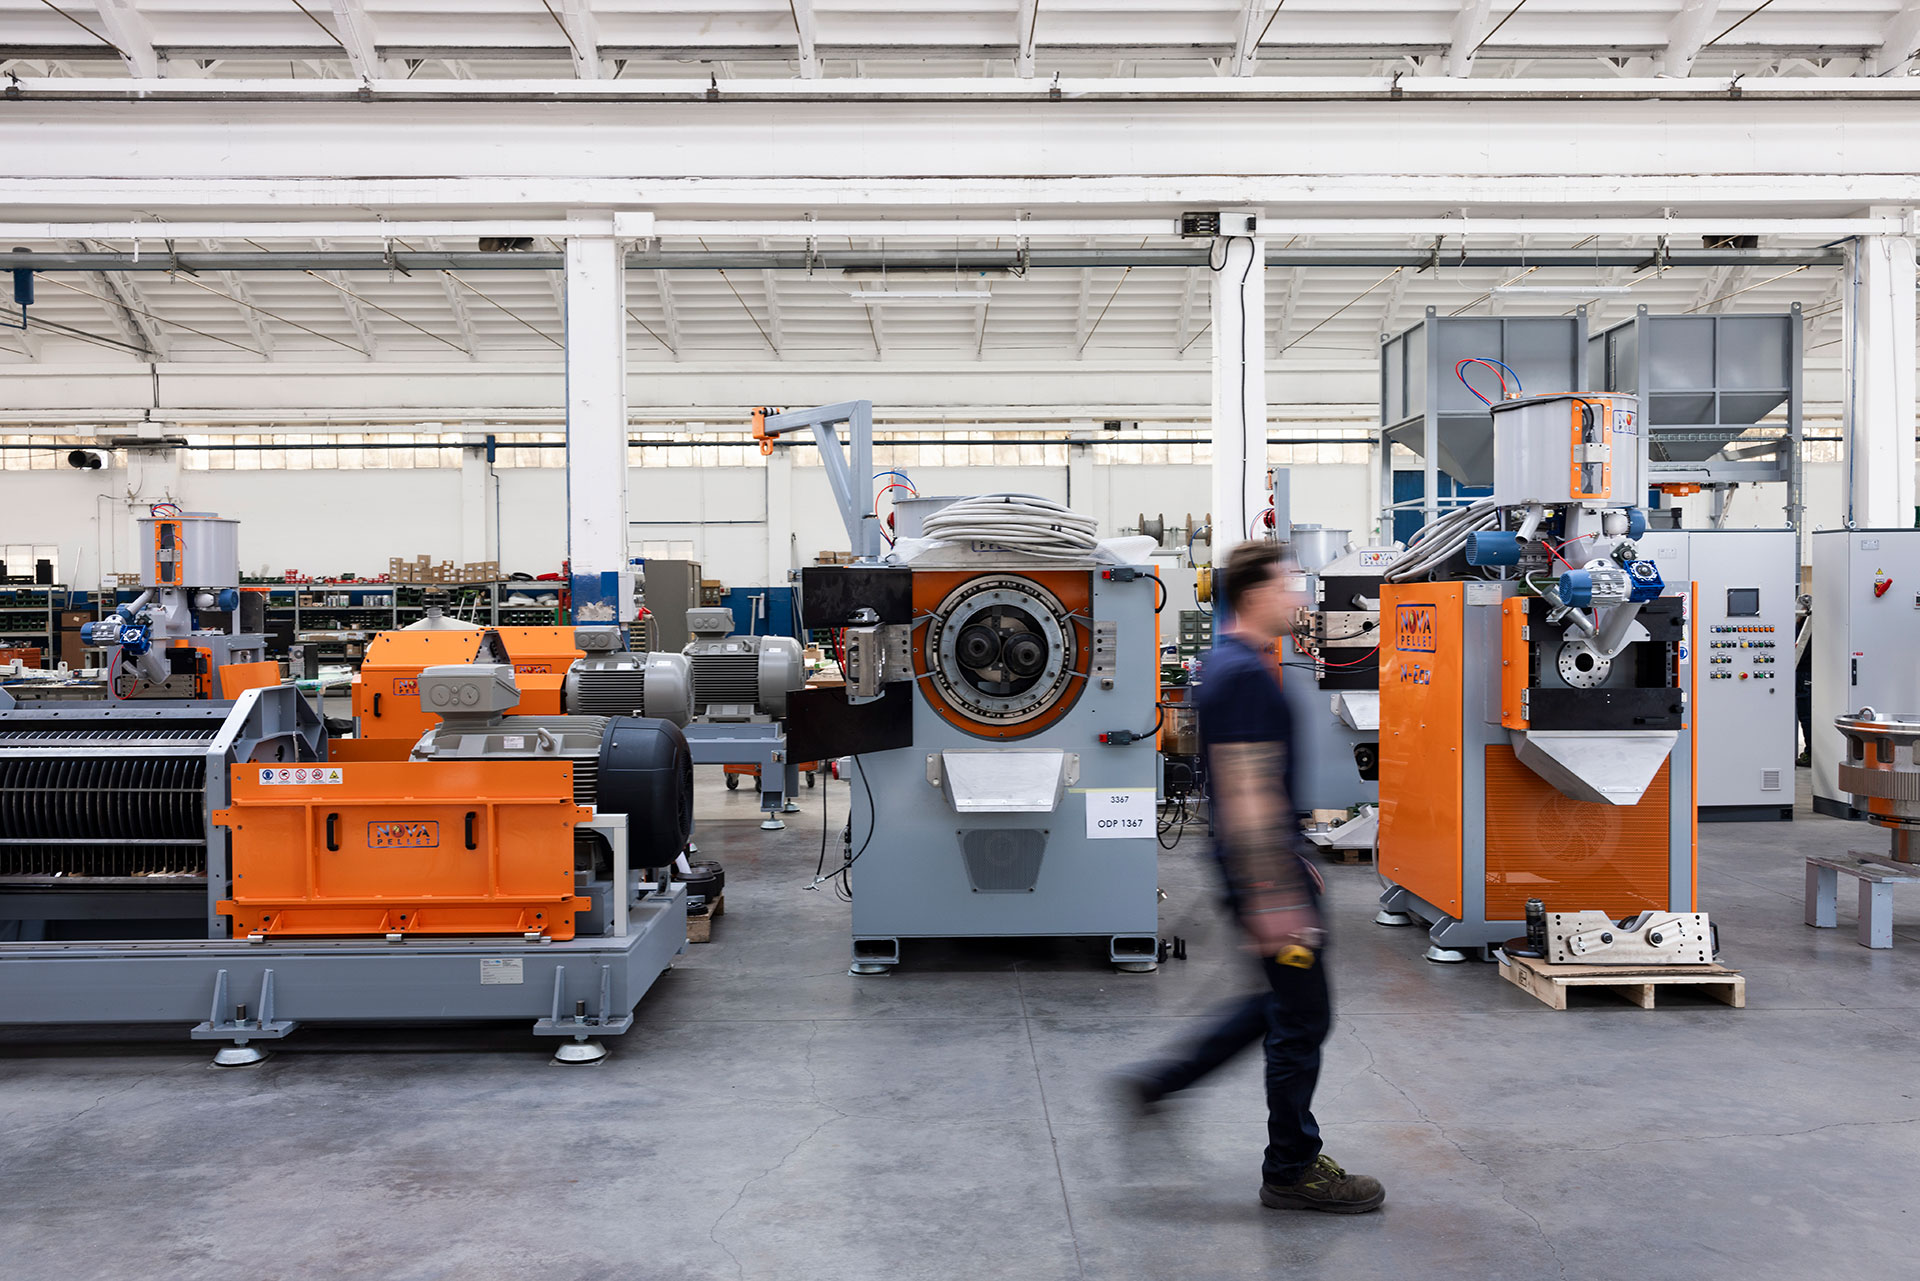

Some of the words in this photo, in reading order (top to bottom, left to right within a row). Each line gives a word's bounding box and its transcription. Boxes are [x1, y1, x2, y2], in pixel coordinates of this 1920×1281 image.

[1364, 553, 1394, 561] NOVA
[1401, 609, 1431, 634] NOVA
[1401, 635, 1432, 647] PELLET
[399, 680, 417, 689] NO
[1097, 819, 1118, 828] ODP
[1121, 819, 1143, 828] 1367
[376, 824, 430, 838] NOVA
